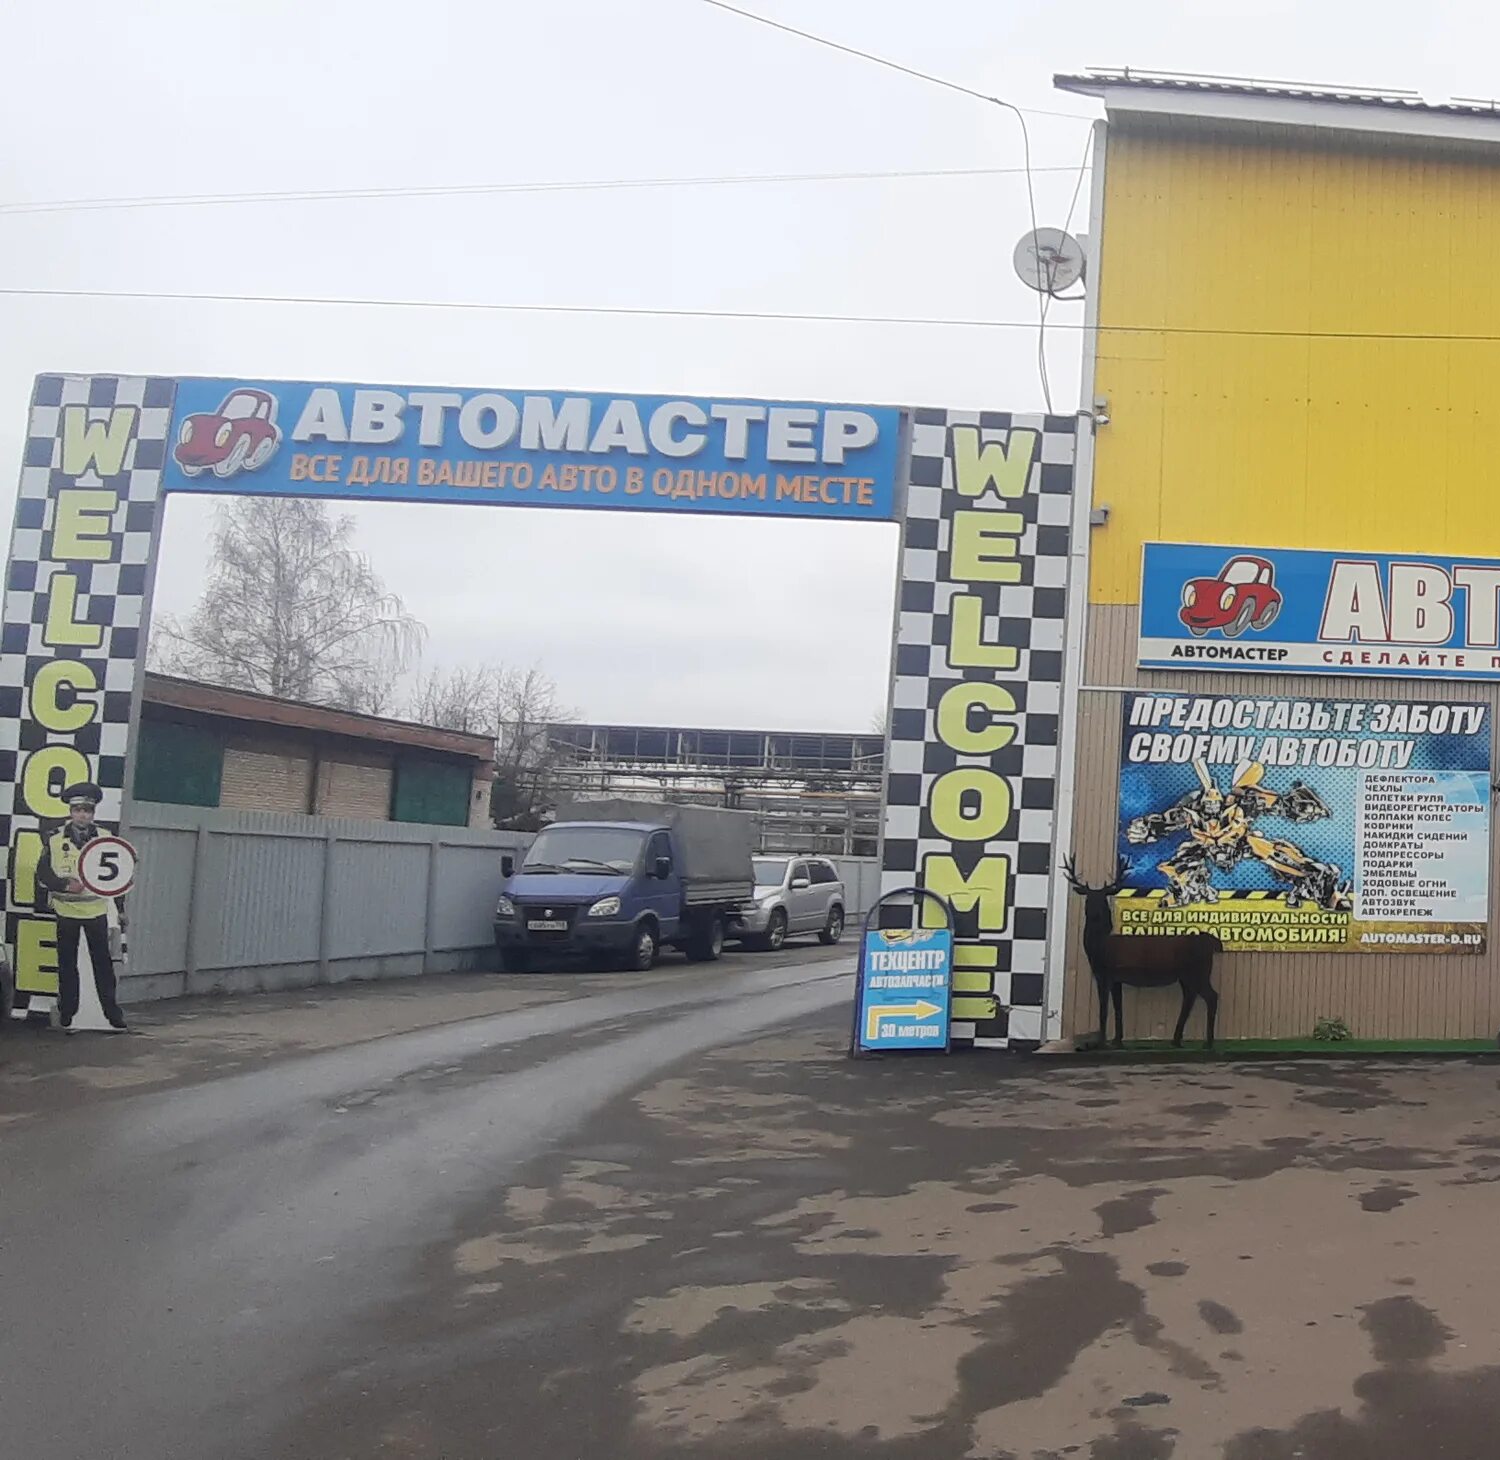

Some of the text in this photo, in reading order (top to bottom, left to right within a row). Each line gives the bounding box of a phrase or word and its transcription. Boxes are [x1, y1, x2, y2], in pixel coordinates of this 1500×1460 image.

[291, 388, 880, 465] АВТОМАСТЕР
[289, 453, 875, 505] ВСЕ ДЛЯ ВАШЕГО АВТО В ОДНОМ МЕСТЕ
[1171, 645, 1289, 661] АВТОМАСТЕР
[1322, 650, 1465, 668] СДЕЛАЙТЕ
[1129, 696, 1485, 736] ПРЕДОСТАВЬТЕ ЗАБОТУ
[922, 425, 1039, 1021] WELCOME
[1127, 731, 1414, 769] СВОЕМУ АВТОБОТУ
[1364, 775, 1435, 784] ДЕФЛЕКТОРА
[1364, 794, 1413, 802] ОПЛЕТКИ
[1364, 804, 1484, 812] ВИДЕОРЕГИСТРАТОРЫ
[1364, 813, 1451, 822] КОЛПАКИ КОЛЕС
[1364, 822, 1413, 830] КОВРИКИ
[1363, 832, 1468, 841] НАКИДКИ СИДЕНИЙ
[1363, 841, 1423, 850] ДОМКРАТЫ
[1363, 851, 1444, 859] КОМПРЕССОРЫ
[97, 851, 119, 882] 5
[1363, 860, 1413, 868] ПОДАРКИ
[1363, 870, 1417, 878] ЭМБЛЕМЫ
[1362, 879, 1447, 888] ХОДОВЫЕ ОГНИ
[1362, 889, 1457, 898] ДОП. ОСВЕЩЕНИЕ
[1361, 898, 1416, 907] АВТОЗВУК
[1361, 908, 1433, 916] АВТОКРЕПЕЖ
[1121, 910, 1348, 925] ВСЕ ДЛЯ ИНДИВИДУАЛЬНОСТИ
[1361, 932, 1482, 945] AUTOMASTER-D.RU
[870, 950, 946, 973] ТЕХЦЕНТР
[869, 974, 944, 989] АВТОЗАПЧАСТИ
[881, 1025, 939, 1039] 30 метров
